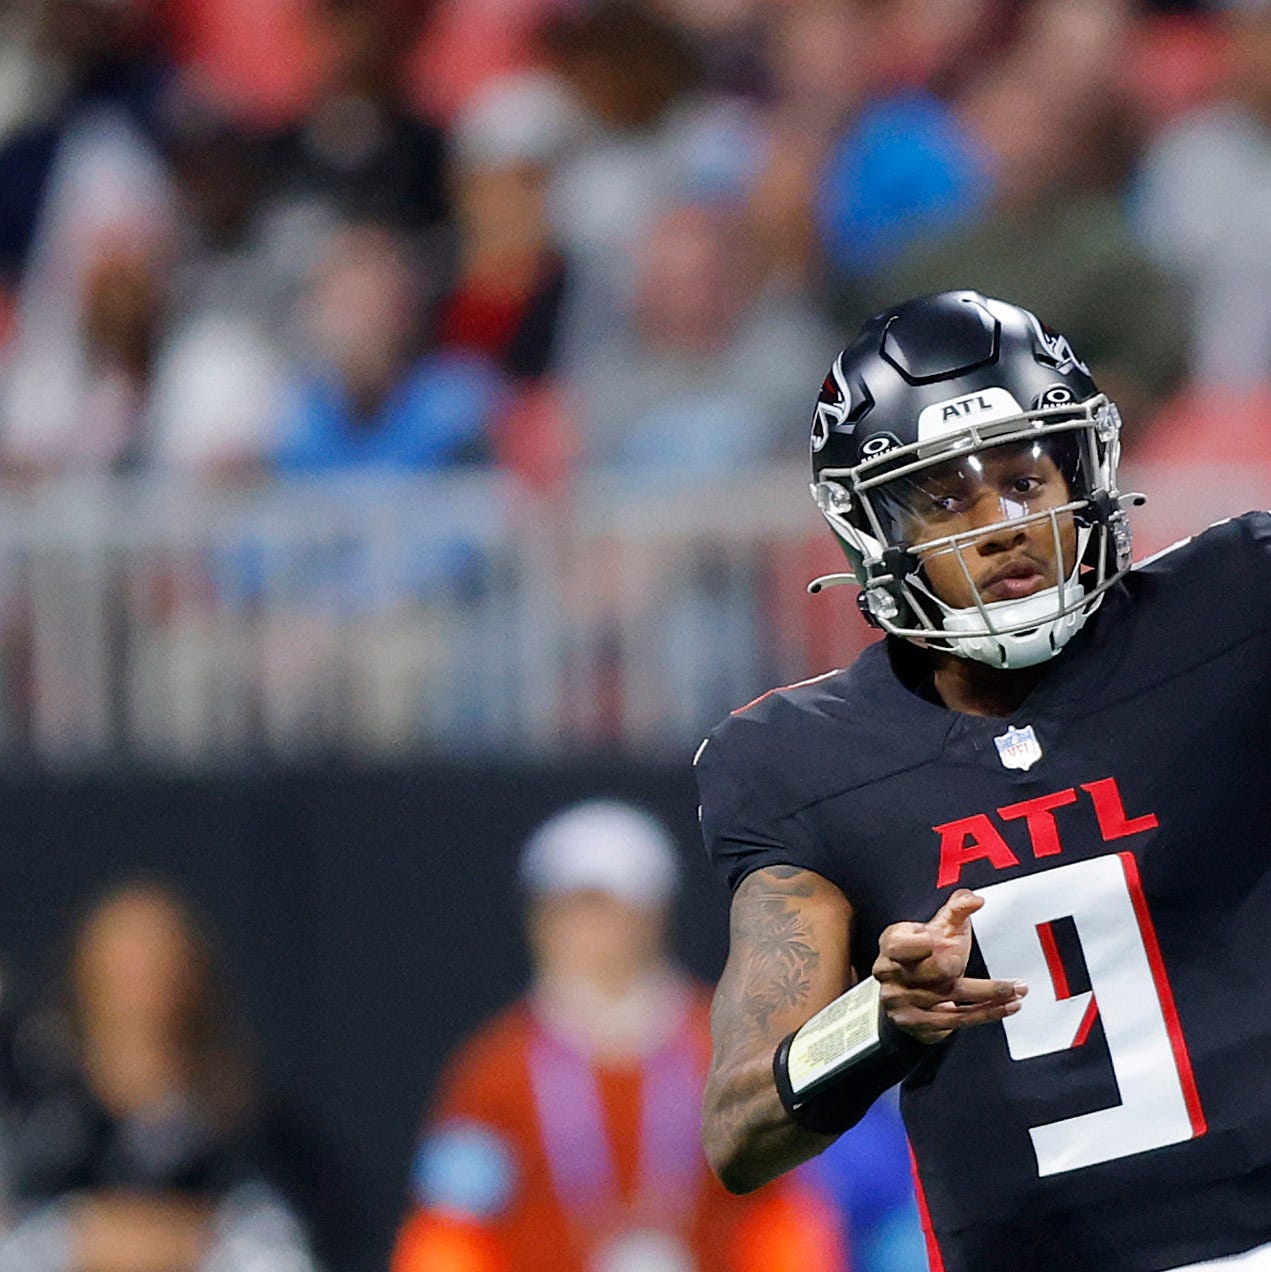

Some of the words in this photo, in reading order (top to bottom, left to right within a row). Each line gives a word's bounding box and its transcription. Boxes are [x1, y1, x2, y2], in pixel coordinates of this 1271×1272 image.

[942, 396, 992, 421] ATL
[932, 776, 1158, 888] ATL
[971, 851, 1206, 1178] 9
